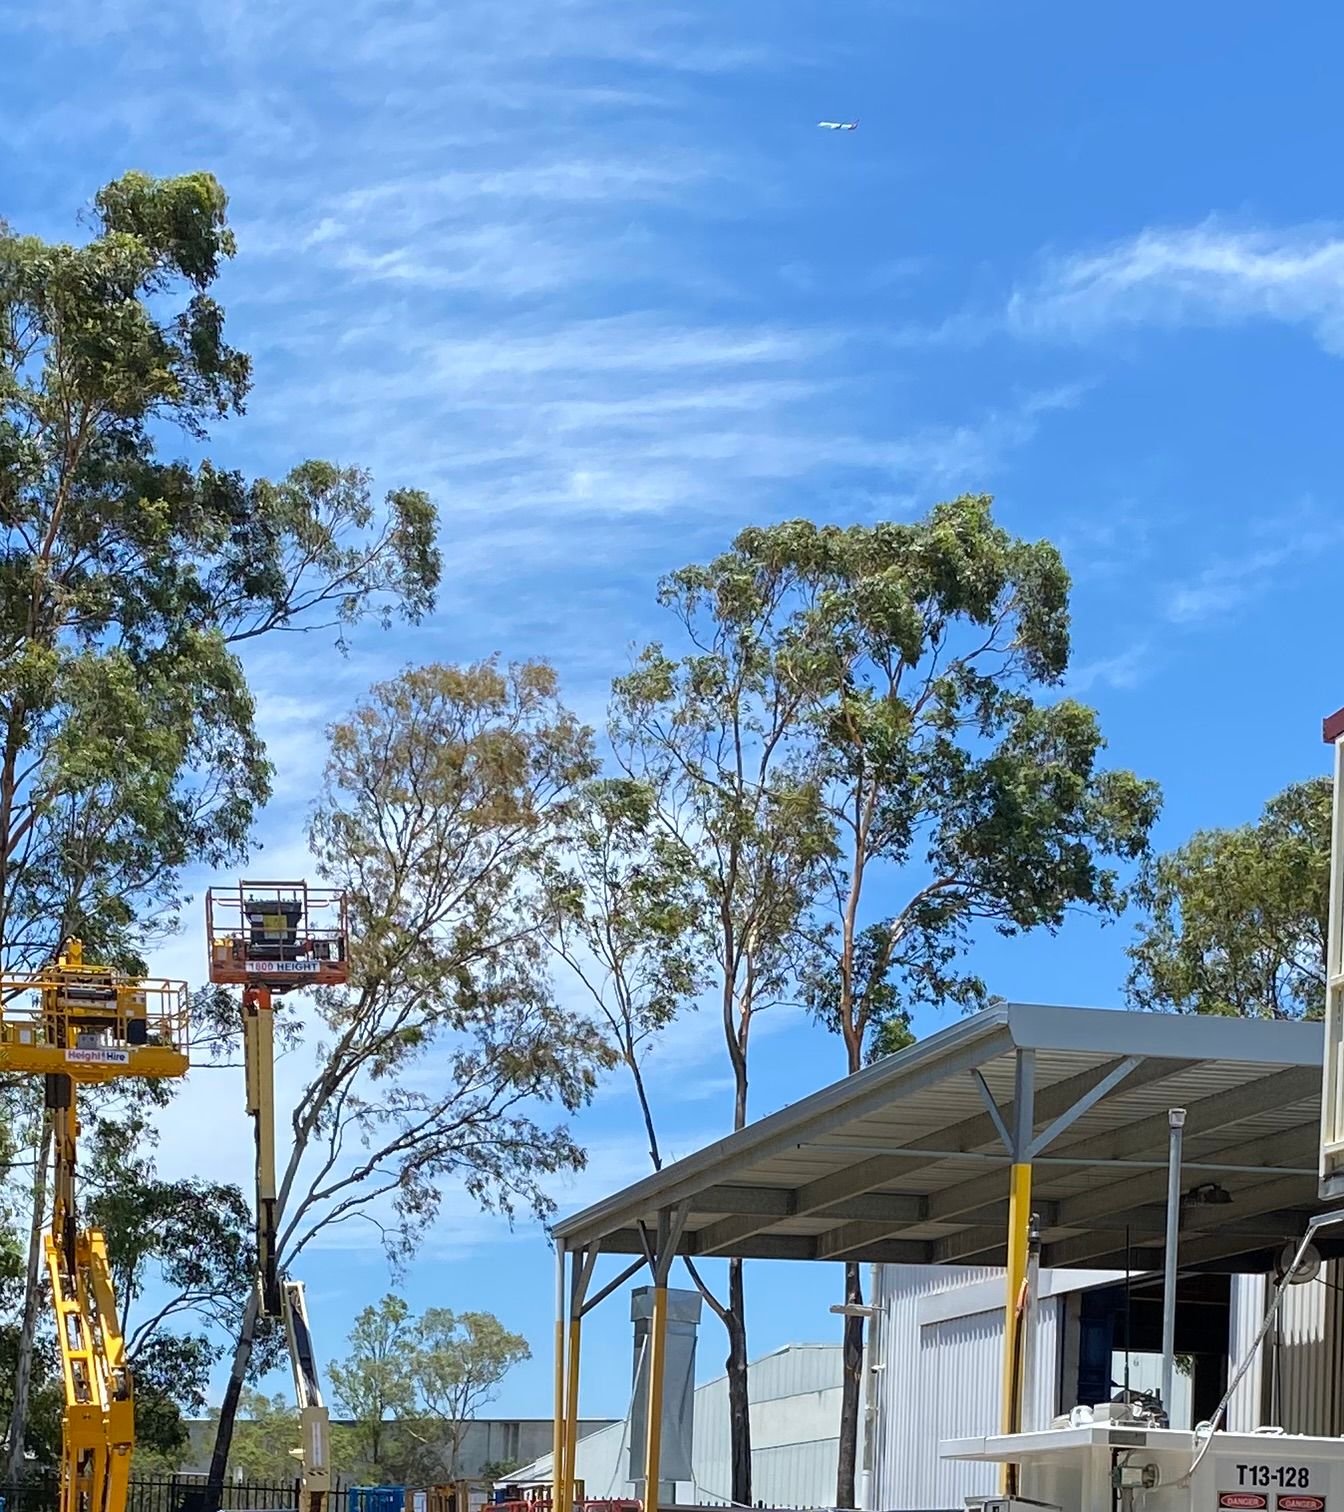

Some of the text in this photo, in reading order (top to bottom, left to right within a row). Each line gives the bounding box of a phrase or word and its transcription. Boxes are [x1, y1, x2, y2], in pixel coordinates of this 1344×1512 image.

[276, 962, 318, 971] HEIGHT
[1236, 1464, 1310, 1488] T13-128
[1226, 1497, 1260, 1506] DANGER
[1285, 1499, 1317, 1508] DANGER
